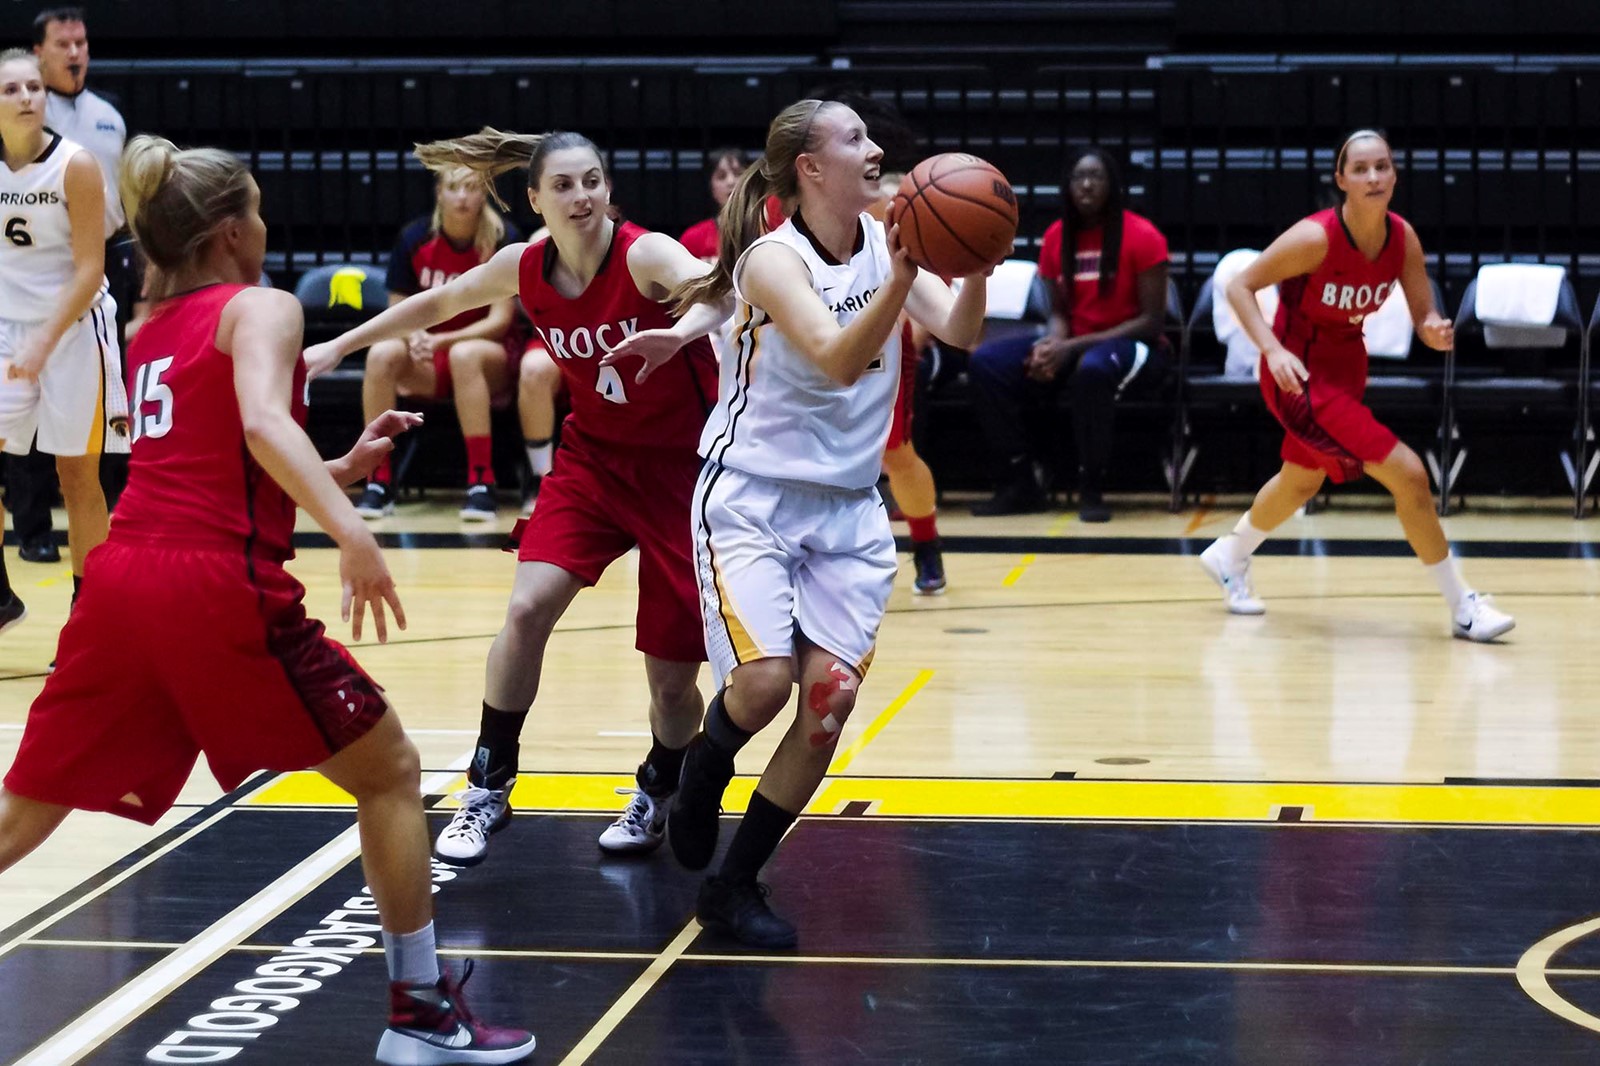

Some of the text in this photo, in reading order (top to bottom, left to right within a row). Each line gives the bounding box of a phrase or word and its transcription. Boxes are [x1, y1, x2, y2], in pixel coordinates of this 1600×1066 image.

[0, 191, 60, 205] RRIORS
[4, 216, 33, 247] 6
[131, 355, 175, 445] 15
[595, 365, 629, 404] 4
